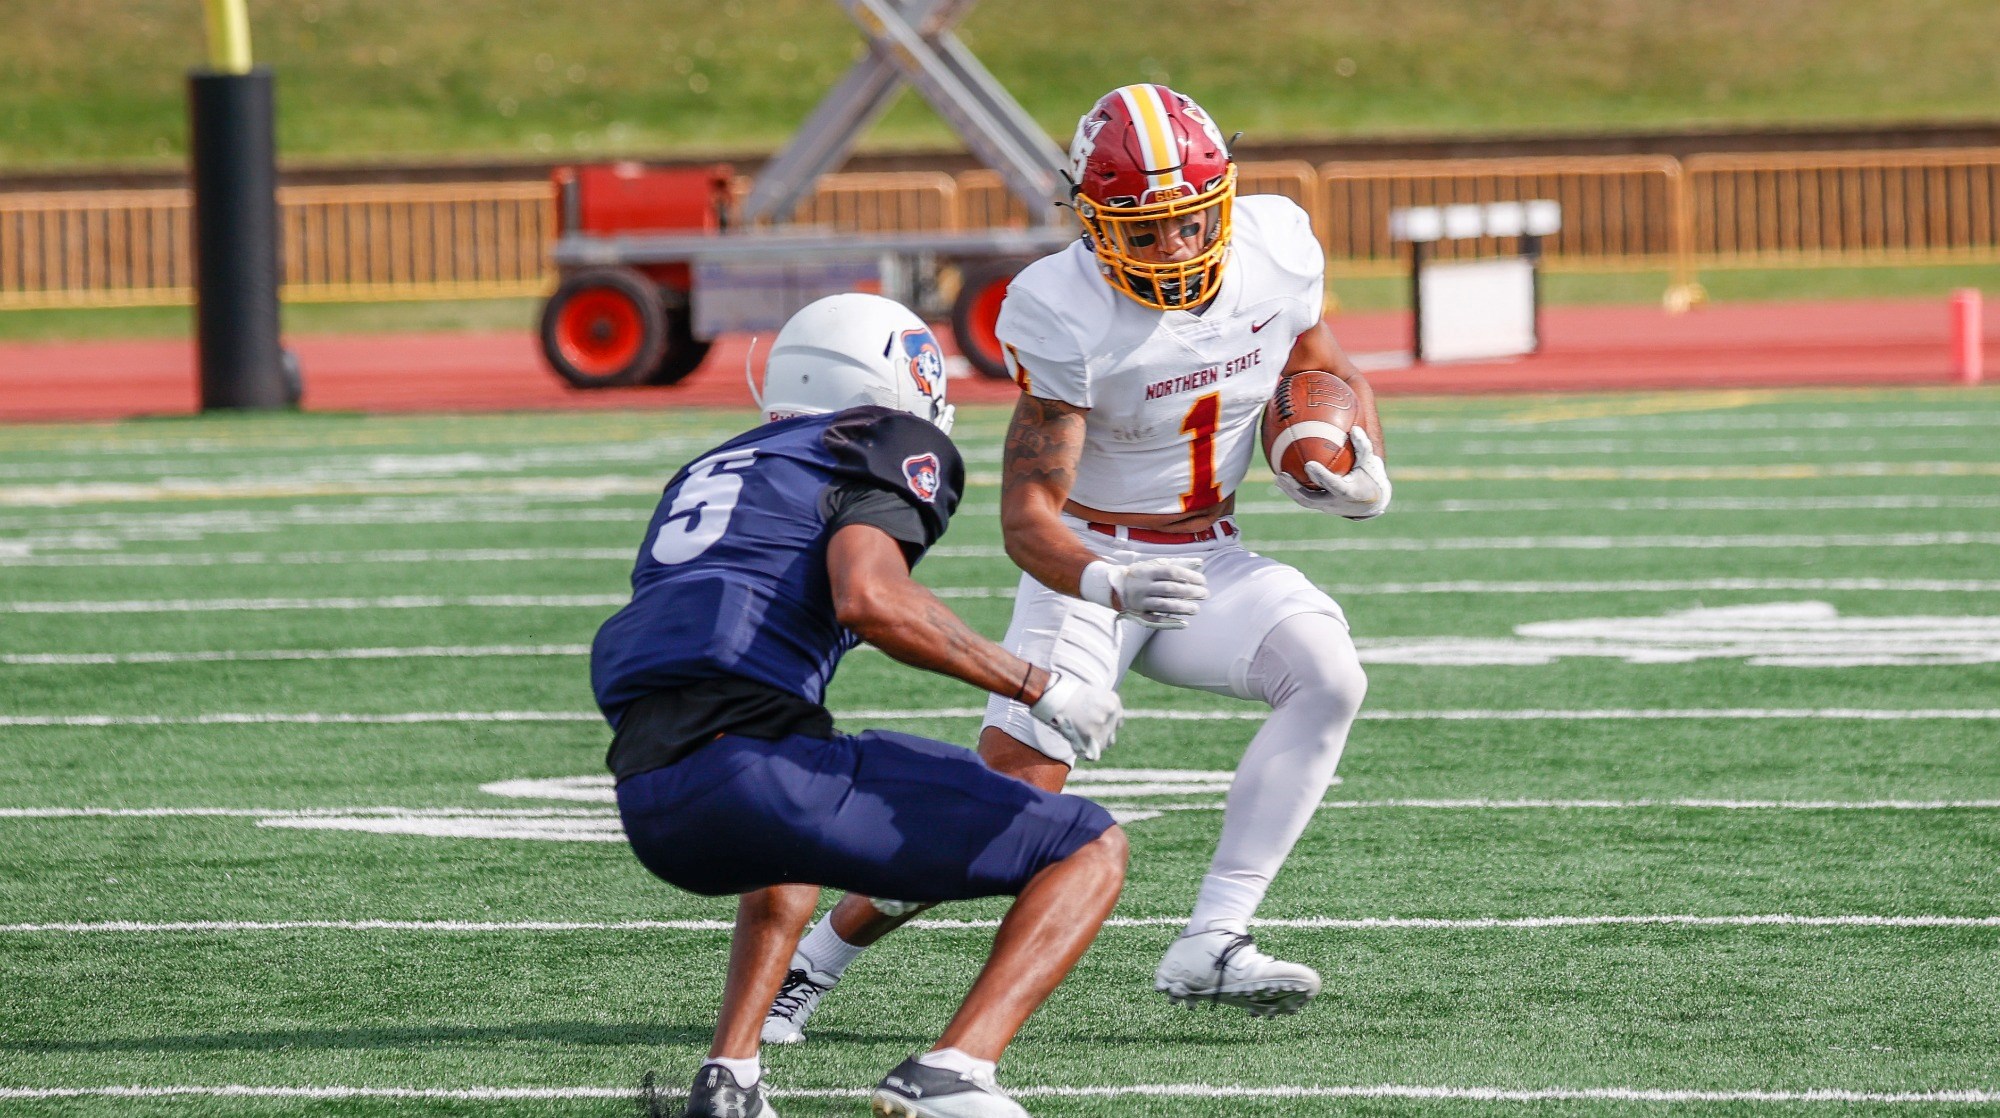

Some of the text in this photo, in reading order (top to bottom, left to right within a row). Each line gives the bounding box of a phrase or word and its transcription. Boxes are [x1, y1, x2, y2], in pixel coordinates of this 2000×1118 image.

[1155, 187, 1183, 202] 605
[1145, 347, 1261, 400] NORTHERN STATE
[1178, 390, 1222, 513] 1
[651, 447, 760, 565] 5
